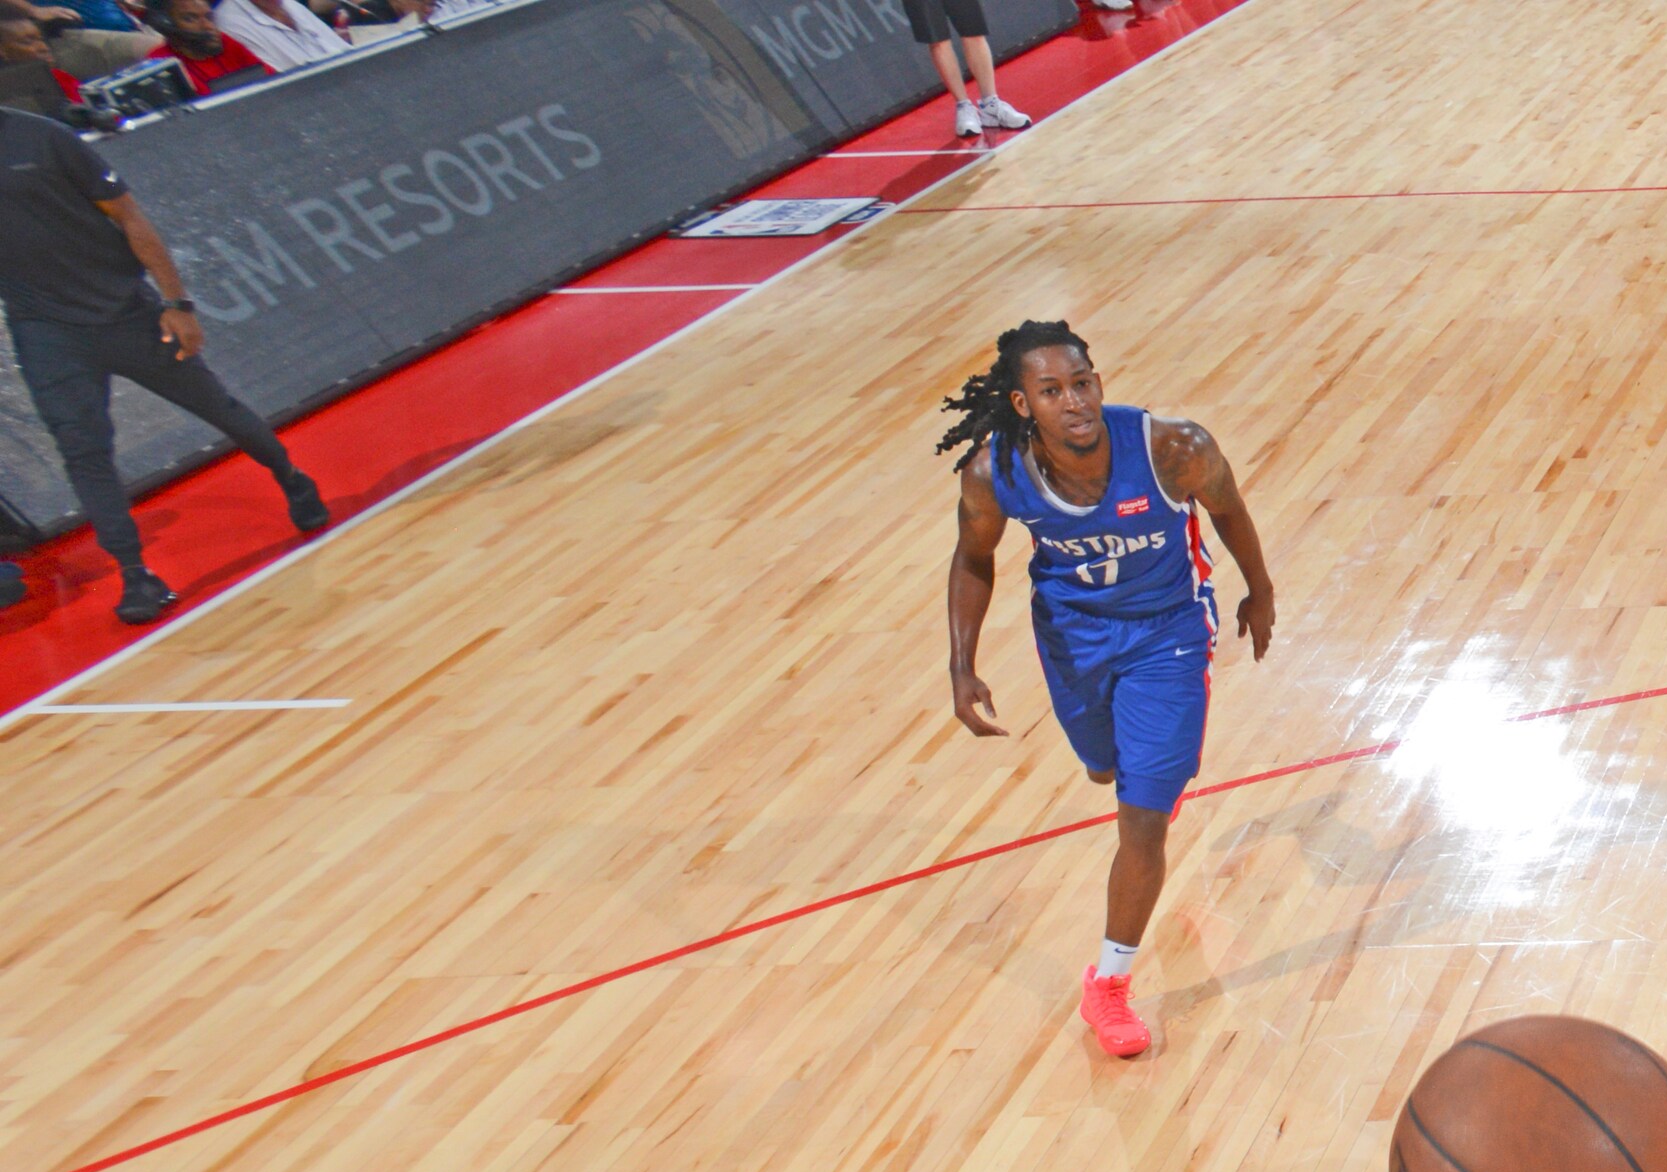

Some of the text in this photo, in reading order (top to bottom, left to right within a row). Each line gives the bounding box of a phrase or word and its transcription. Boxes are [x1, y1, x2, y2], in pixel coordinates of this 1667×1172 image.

[751, 0, 875, 80] MGM
[176, 103, 601, 322] GM RESORTS
[1076, 558, 1119, 586] 17
